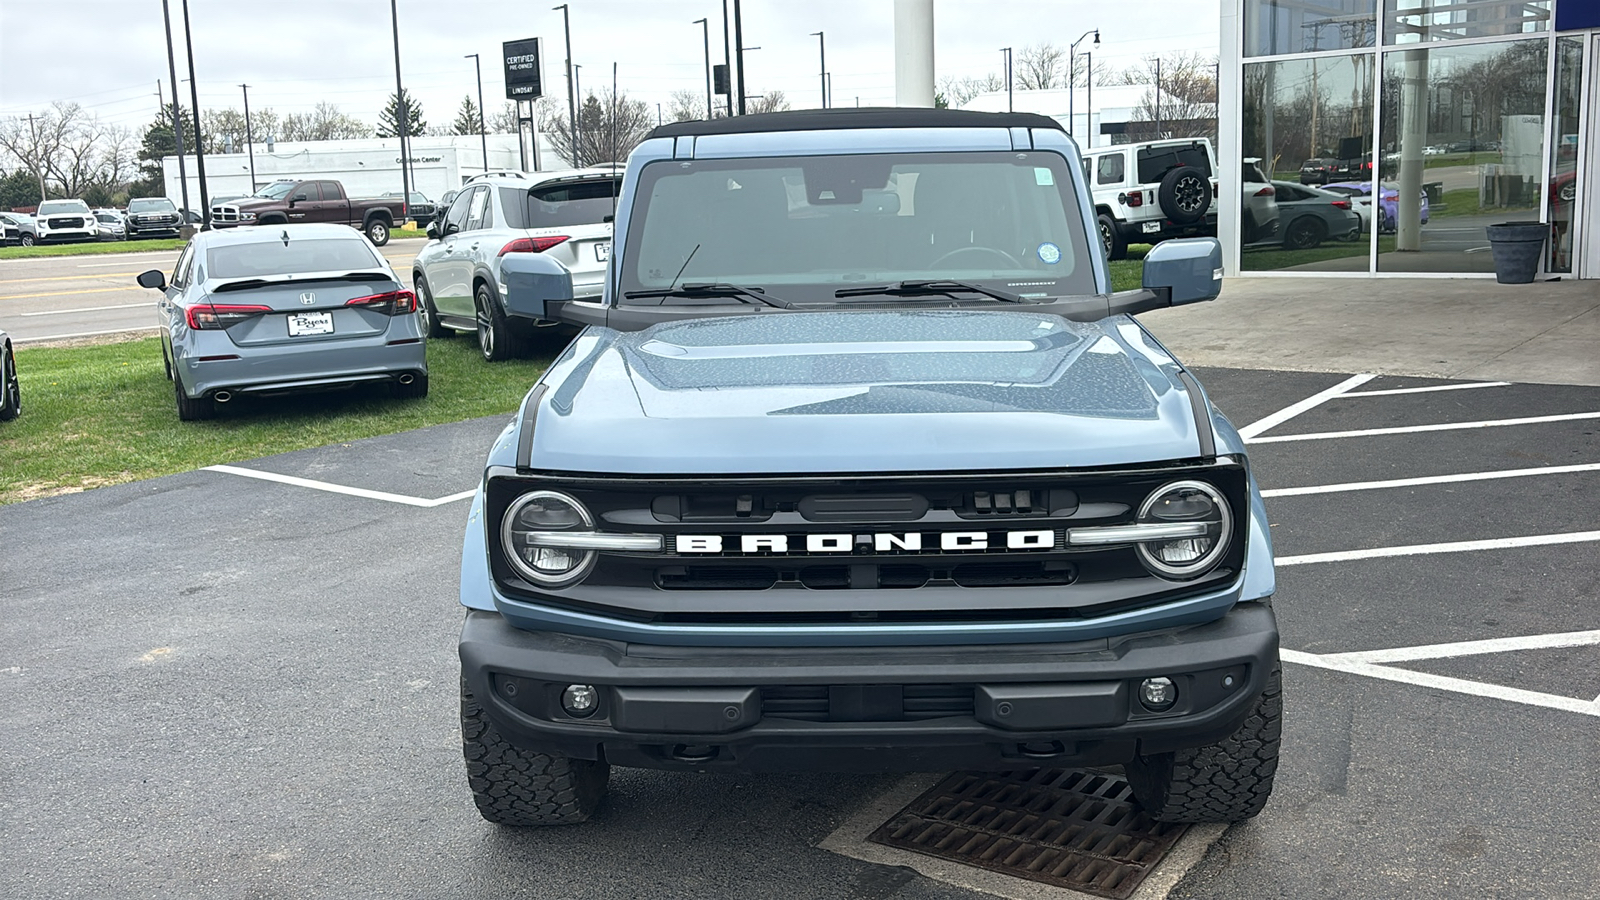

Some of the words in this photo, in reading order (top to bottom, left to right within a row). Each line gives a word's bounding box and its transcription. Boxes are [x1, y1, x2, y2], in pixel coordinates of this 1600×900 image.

[506, 54, 535, 65] CERTIFIED
[512, 86, 533, 95] LINDSAY
[292, 318, 329, 329] Byers
[676, 530, 1054, 553] BRONCO
